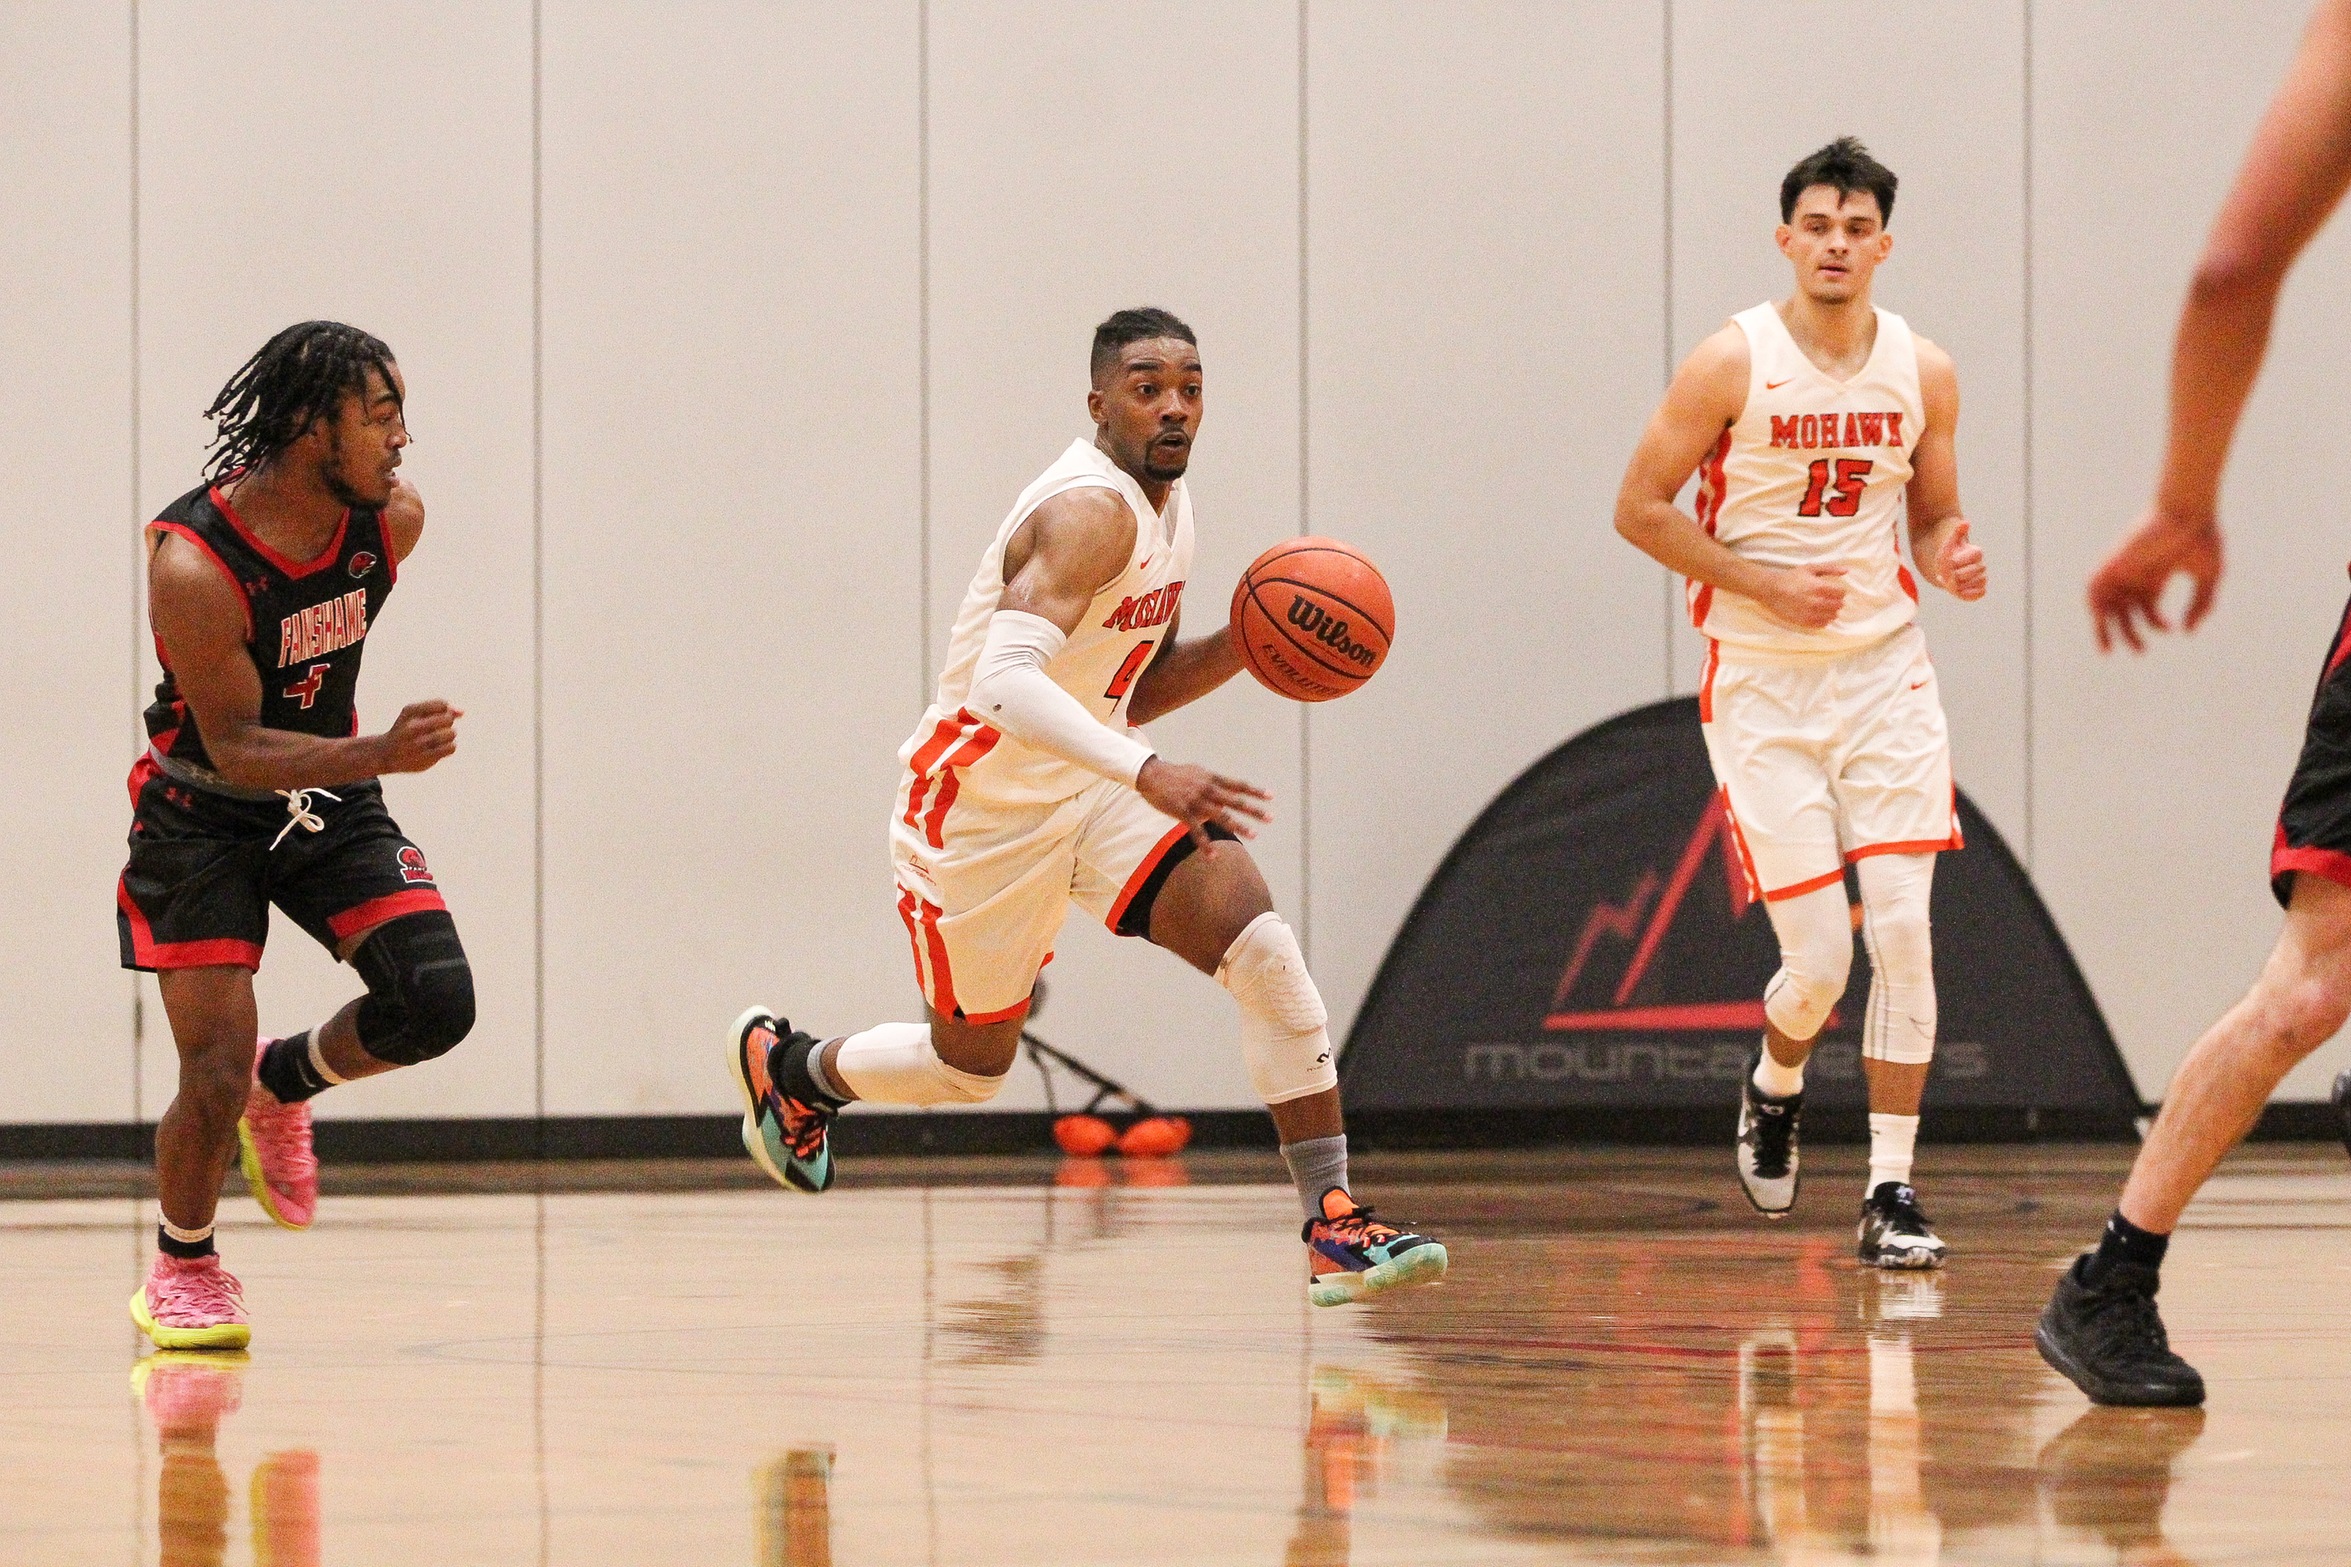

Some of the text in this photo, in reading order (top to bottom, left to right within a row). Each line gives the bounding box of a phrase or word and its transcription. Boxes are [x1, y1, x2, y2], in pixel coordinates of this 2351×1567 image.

[1770, 412, 1904, 450] MOHAWK
[1797, 458, 1874, 517] 15
[277, 587, 368, 668] FANSHAWE
[1287, 593, 1377, 667] Wilson
[1464, 1042, 1989, 1080] mountaes
